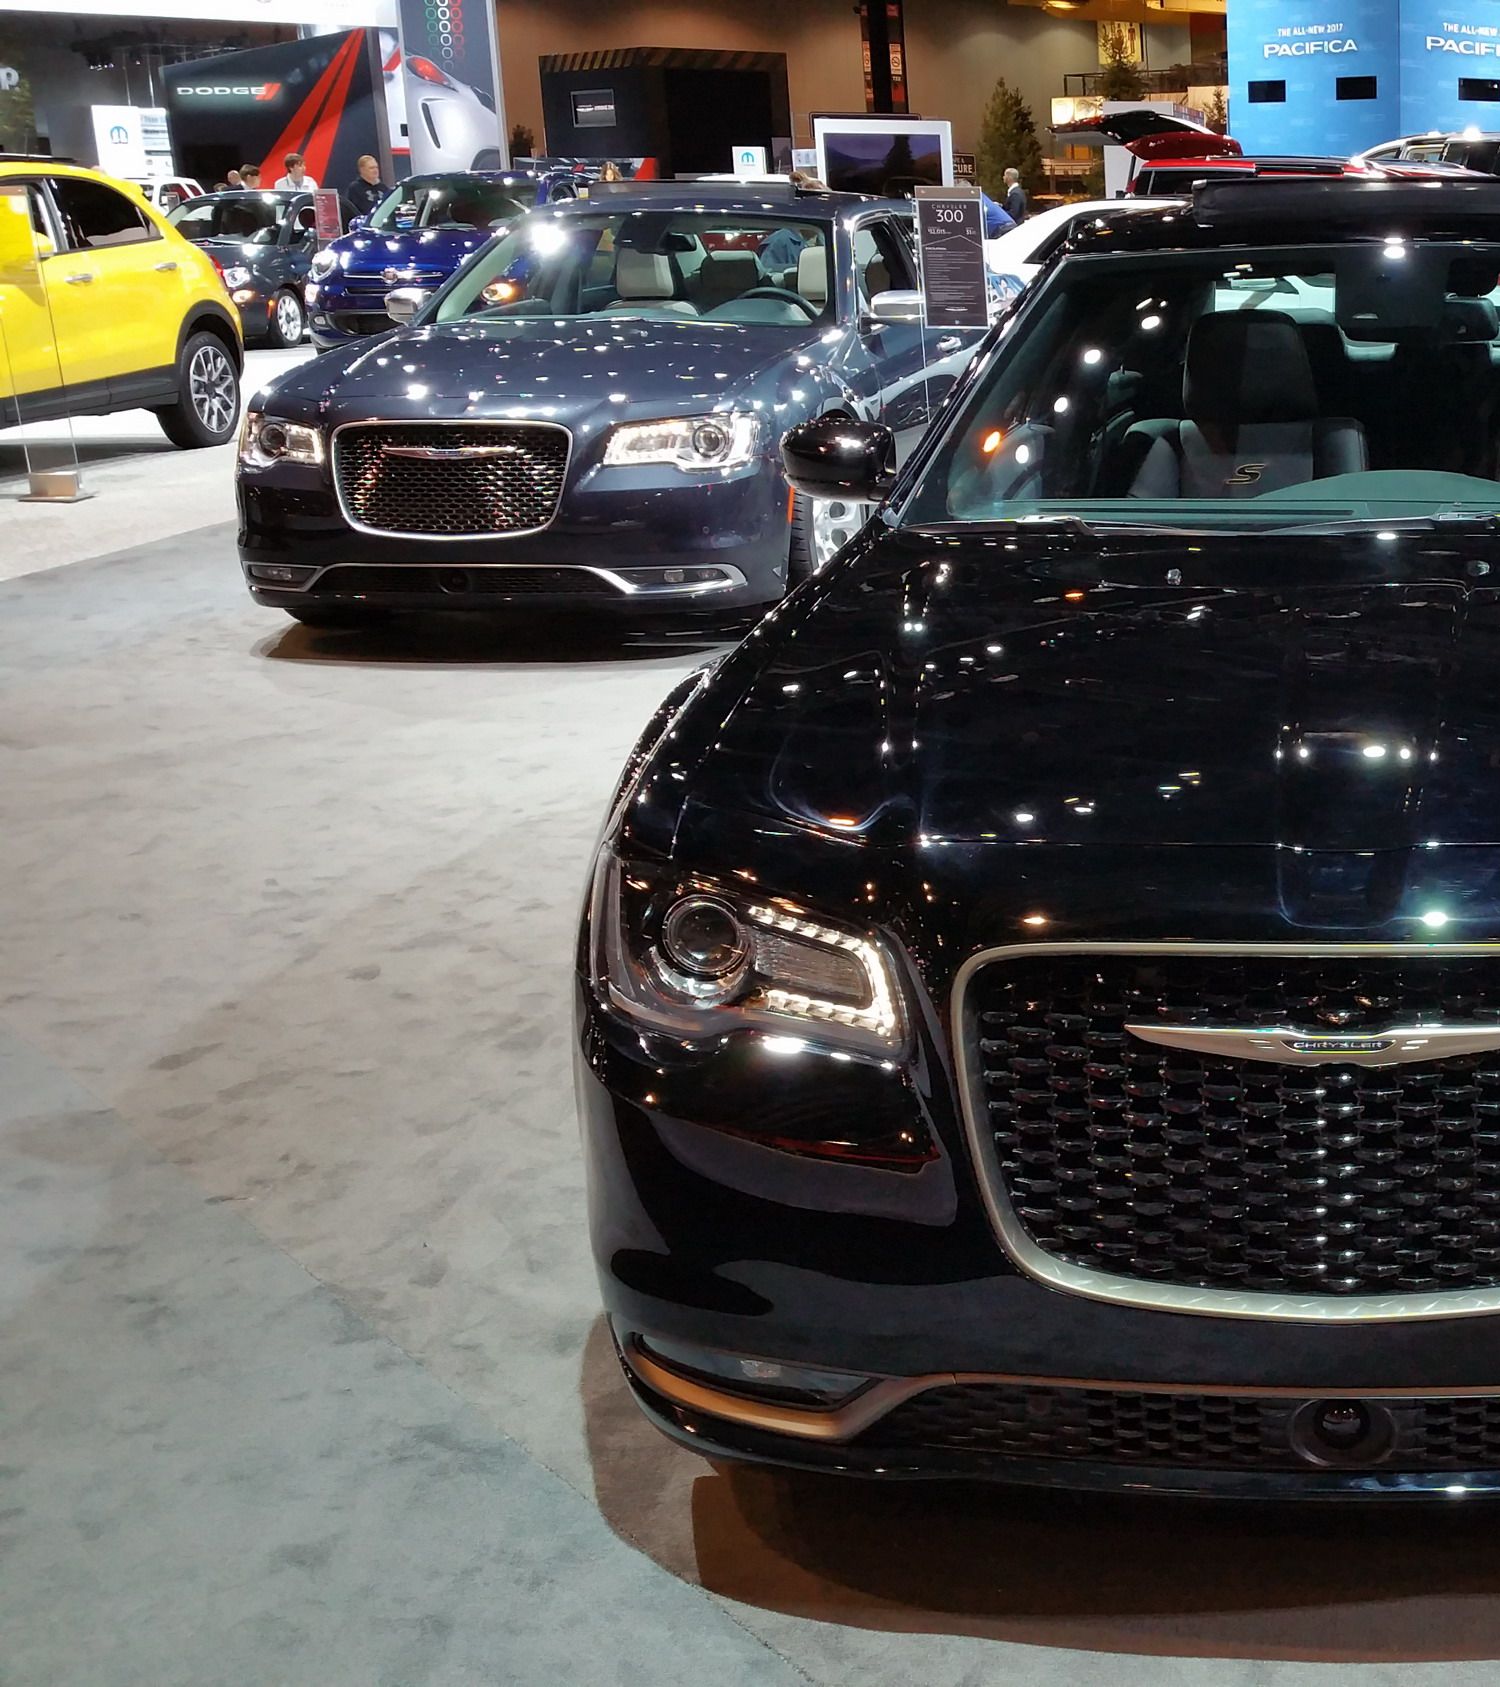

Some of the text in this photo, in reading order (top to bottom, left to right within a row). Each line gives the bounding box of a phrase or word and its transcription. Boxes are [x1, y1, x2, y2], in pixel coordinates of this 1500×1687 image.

[1277, 23, 1343, 37] THE ALL-NEW 2017
[1443, 22, 1460, 33] THE
[1461, 25, 1498, 38] ALL-NEW
[1263, 39, 1358, 58] PACIFICA
[176, 86, 266, 95] DODGE
[935, 209, 964, 222] 300
[1225, 463, 1266, 485] S
[1293, 1041, 1383, 1050] CHRYSLER
